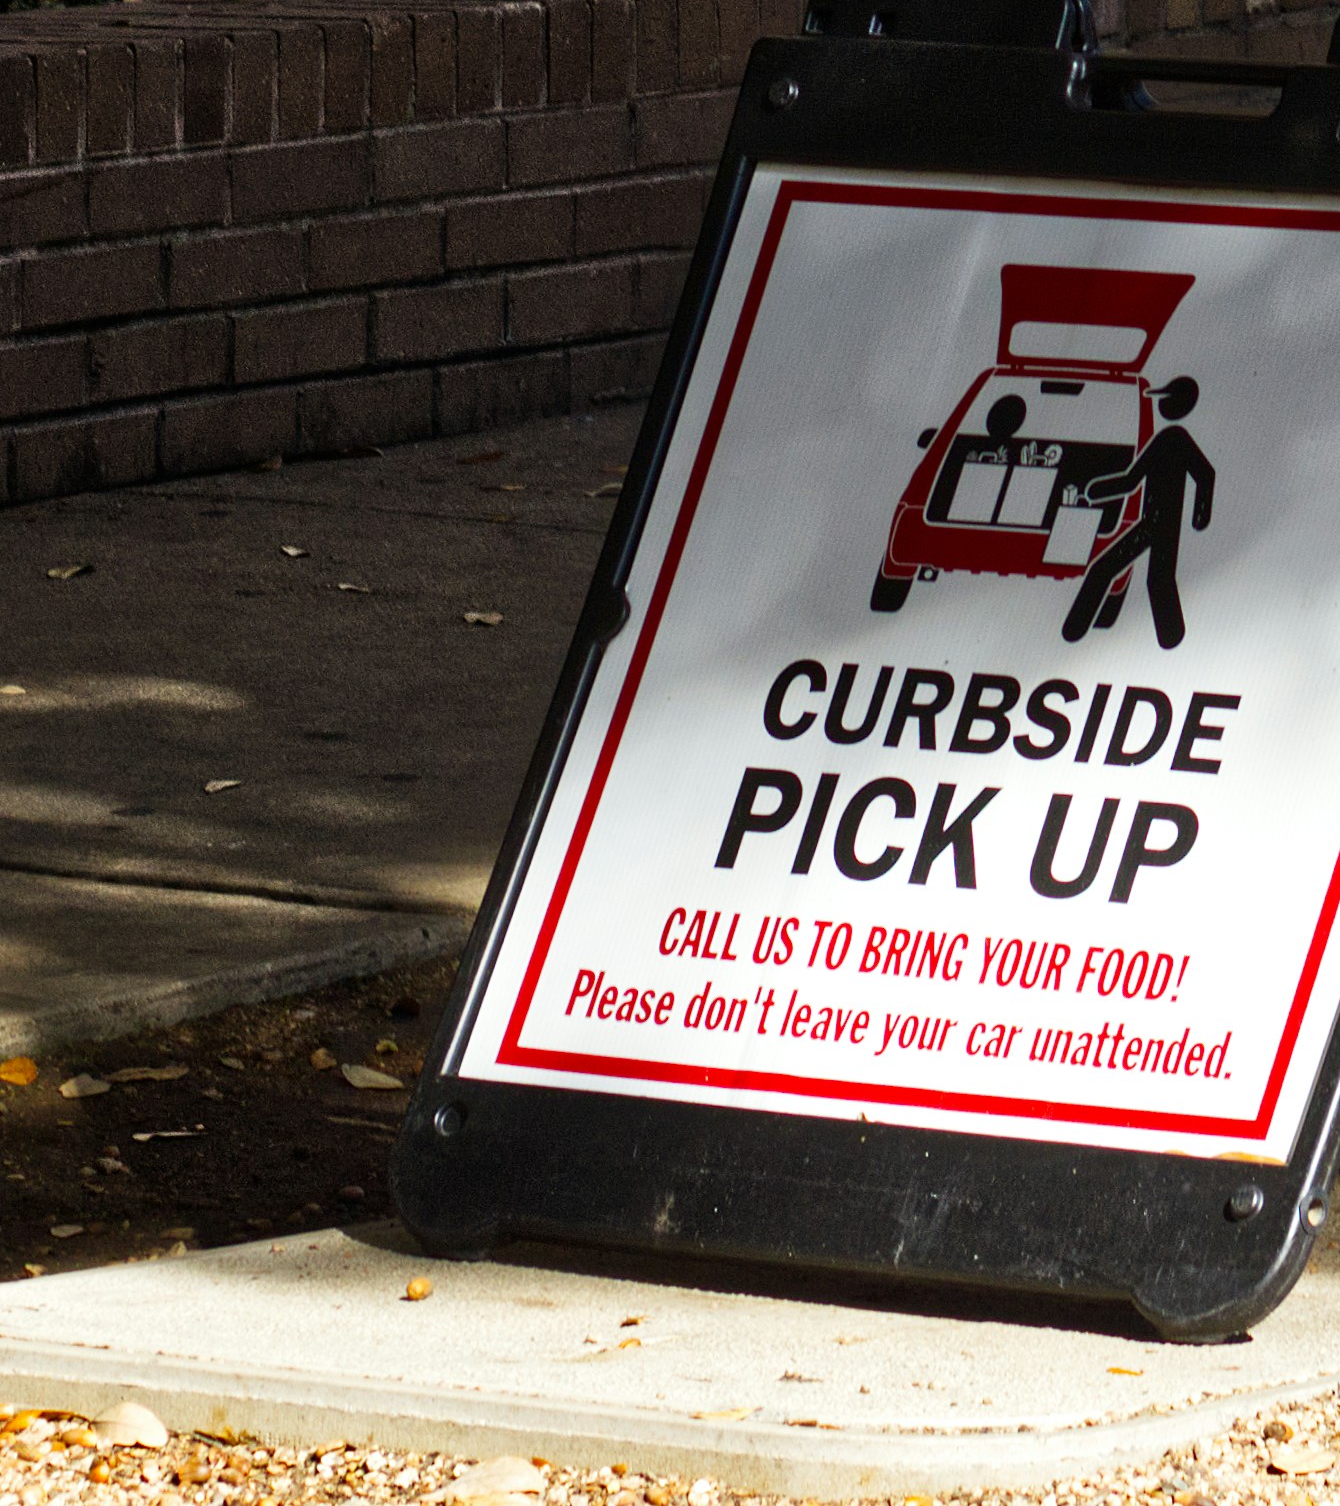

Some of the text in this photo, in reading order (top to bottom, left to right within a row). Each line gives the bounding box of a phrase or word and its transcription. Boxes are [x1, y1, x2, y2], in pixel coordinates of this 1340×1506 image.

[762, 658, 1244, 778] CURBSIDE
[714, 767, 1201, 908] PICK UP
[658, 906, 1191, 1003] CALL US TO BRING YOUR FOOD!
[564, 968, 1234, 1080] Please don't leave your car unattended.
